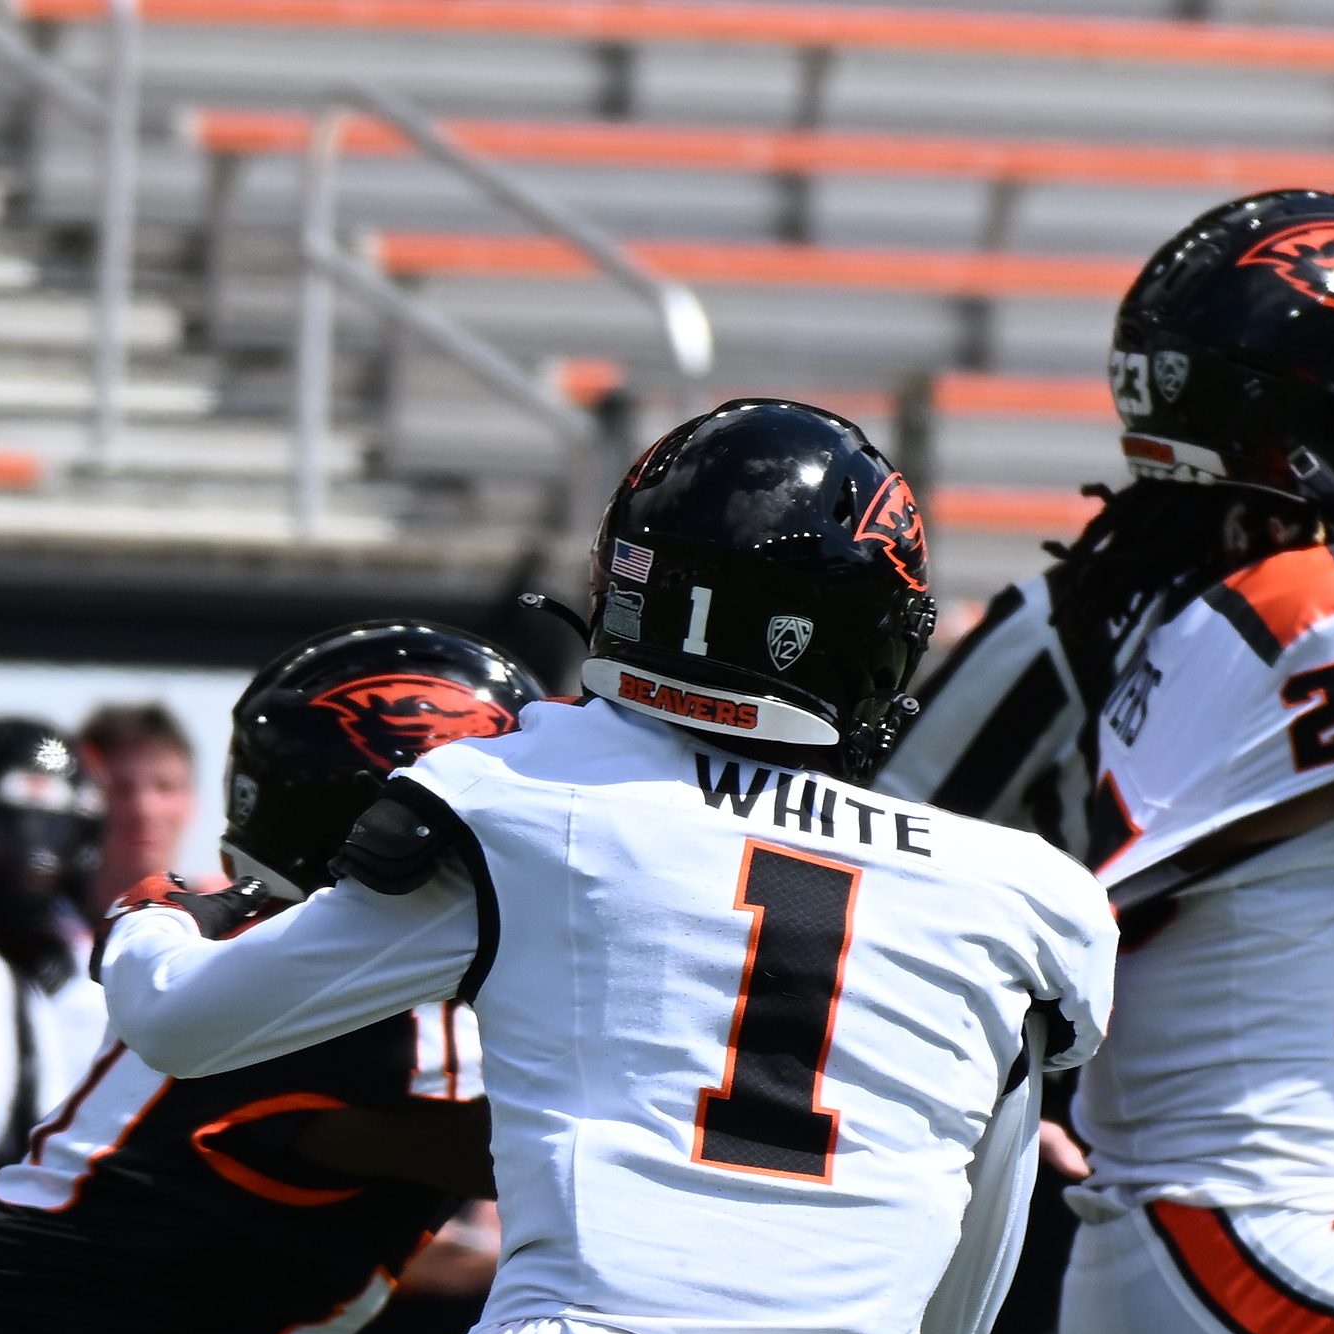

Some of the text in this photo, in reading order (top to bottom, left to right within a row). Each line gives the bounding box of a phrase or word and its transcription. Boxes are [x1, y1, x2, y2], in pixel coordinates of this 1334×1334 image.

[683, 586, 713, 656] 1
[770, 618, 814, 650] PAC
[774, 640, 798, 660] 12
[618, 671, 759, 730] BEAVERS
[695, 753, 932, 858] WHITE
[691, 837, 864, 1186] 1
